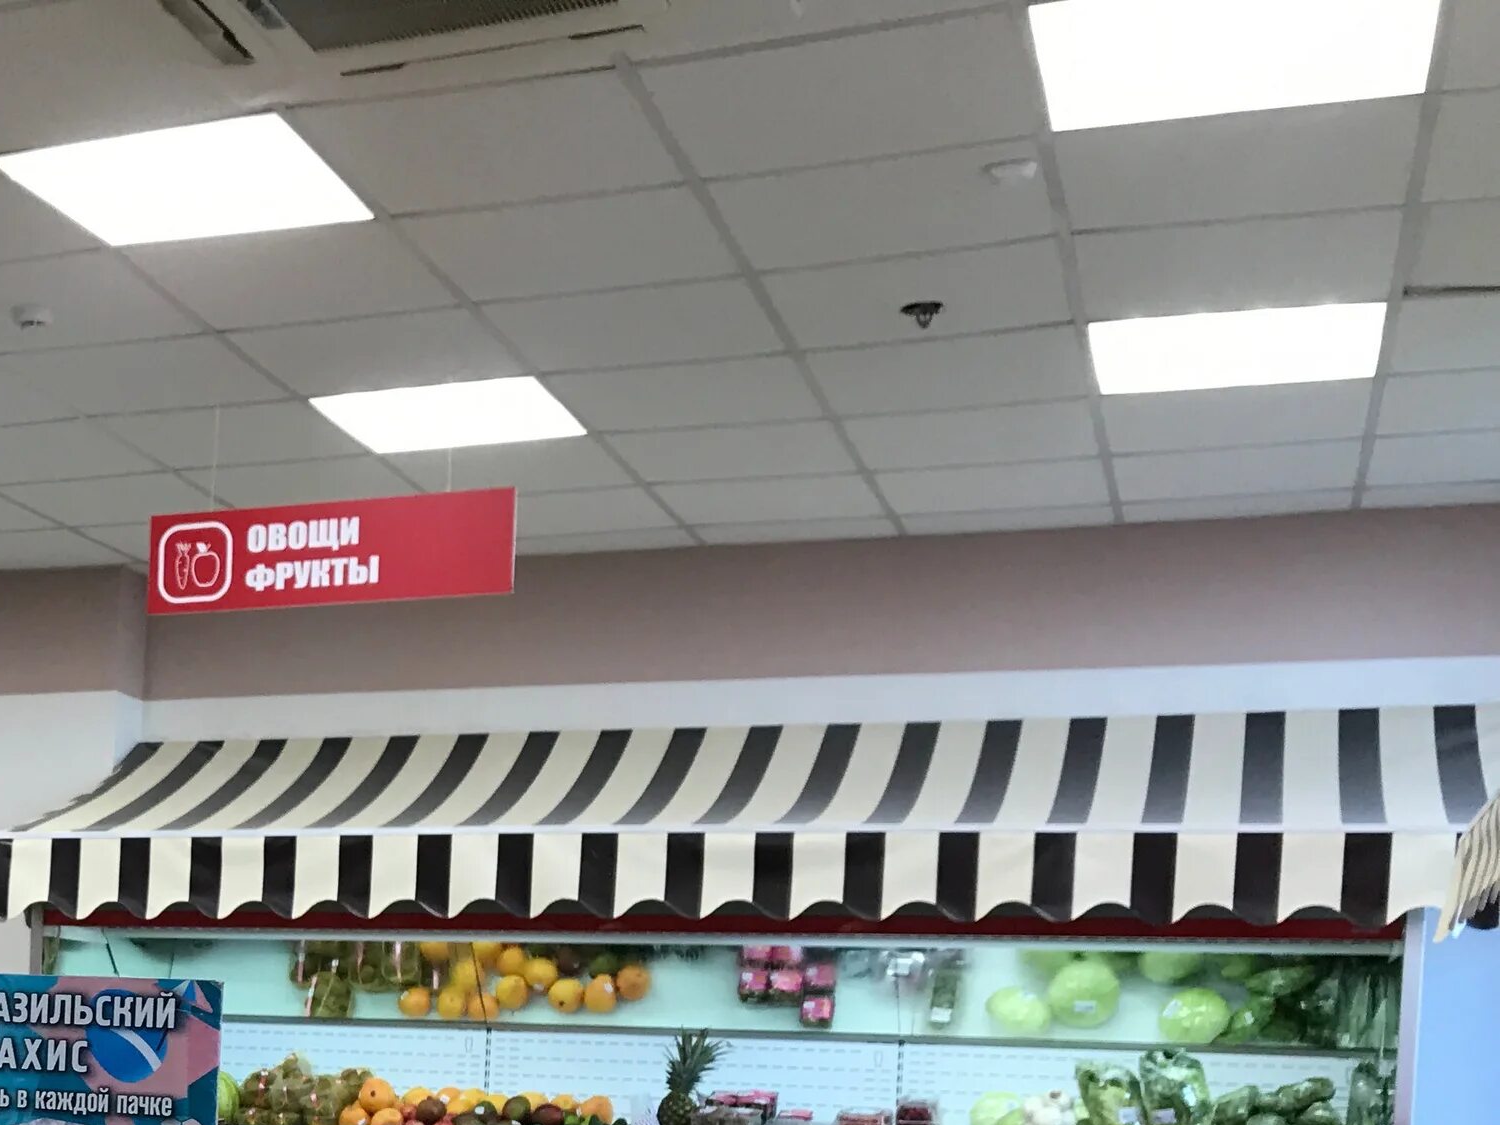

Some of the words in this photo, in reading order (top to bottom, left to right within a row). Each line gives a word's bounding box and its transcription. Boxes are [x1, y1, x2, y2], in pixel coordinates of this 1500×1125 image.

[247, 516, 360, 553] ОВОЩИ
[245, 555, 380, 592] ФРУКТЫ
[17, 1090, 27, 1107] в
[35, 1088, 109, 1116] каждой
[116, 1095, 172, 1117] пачке
